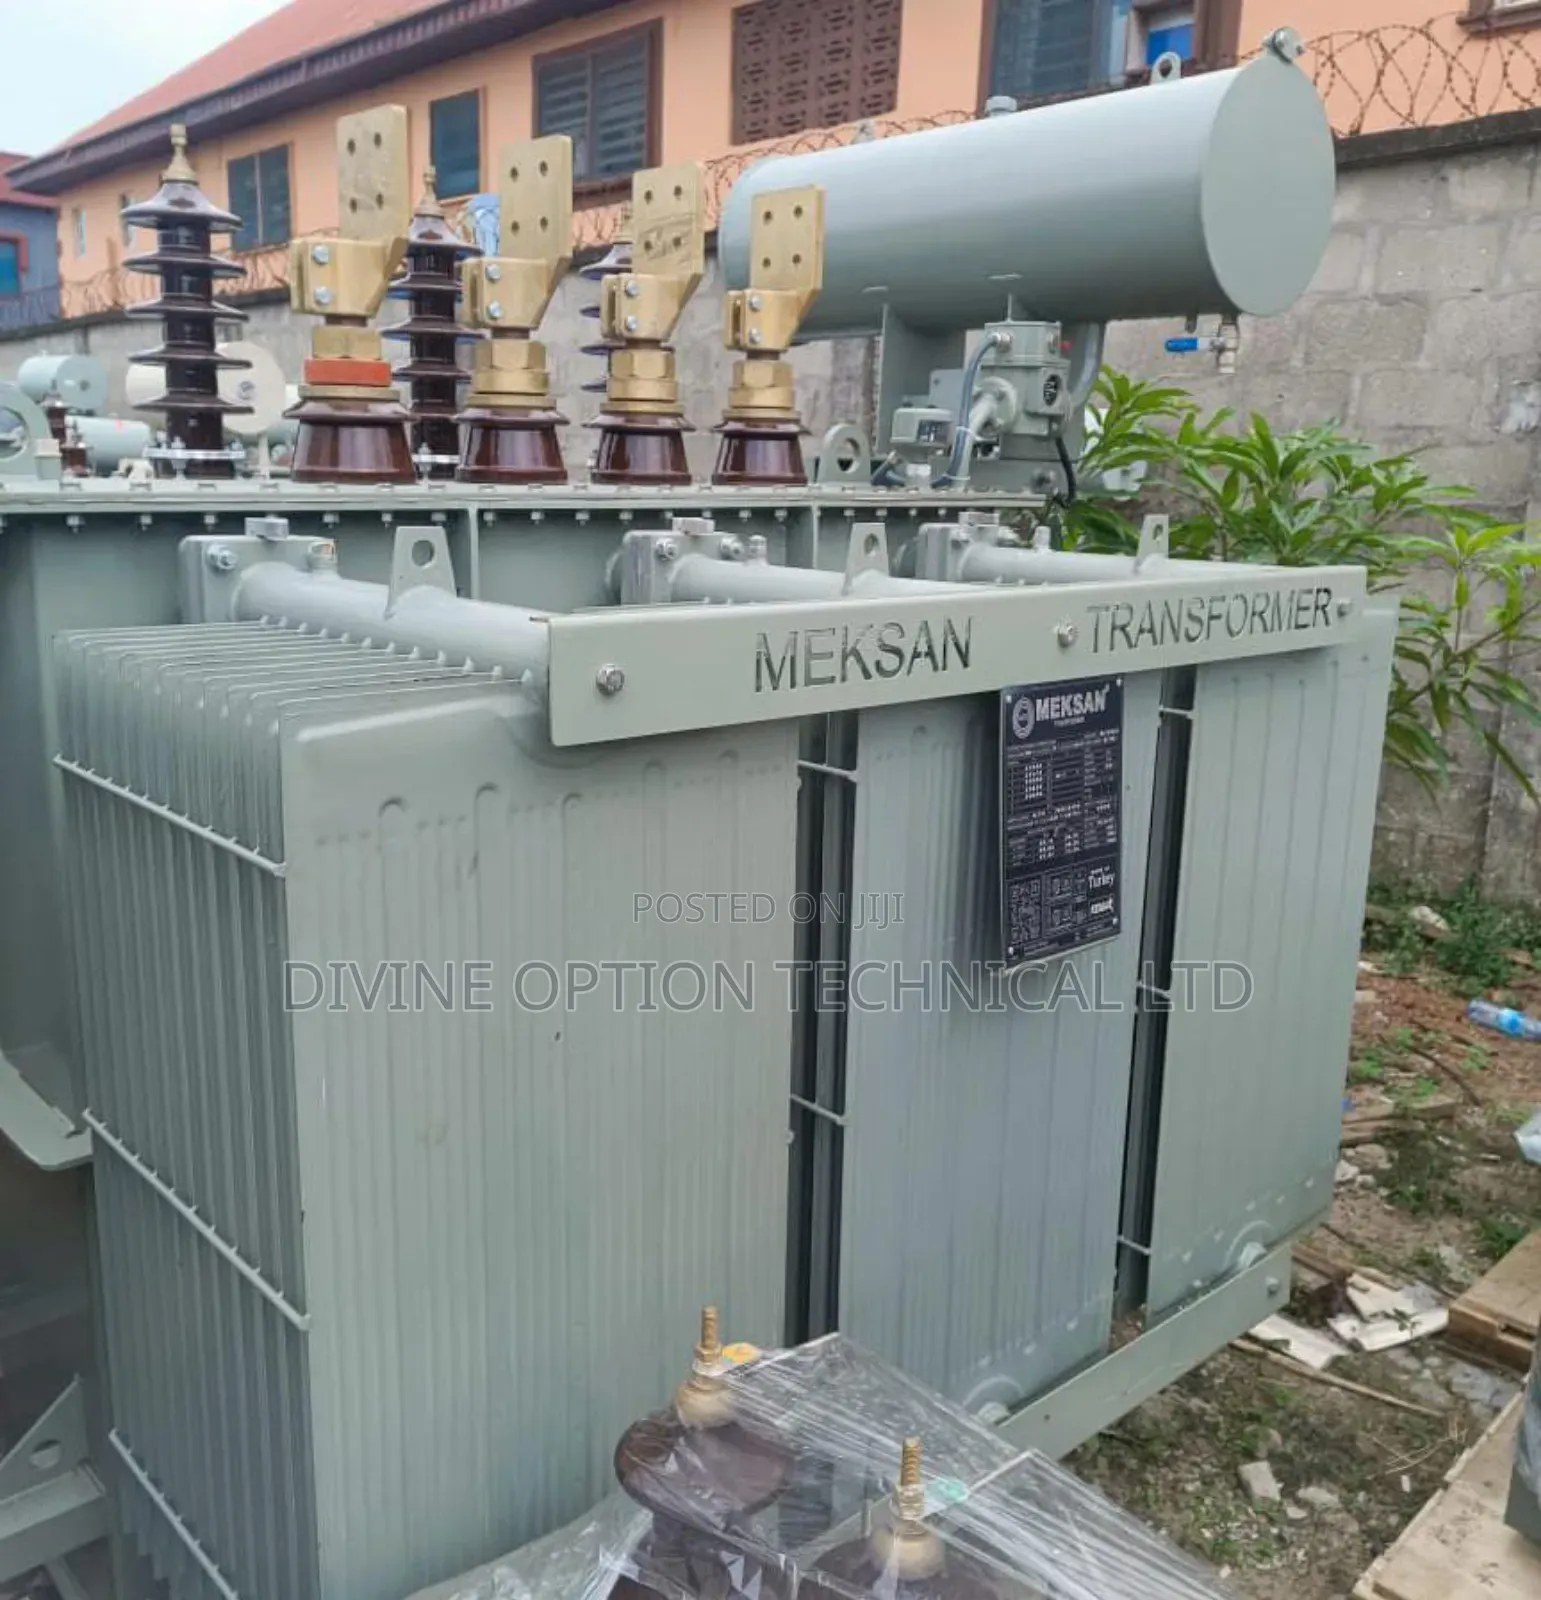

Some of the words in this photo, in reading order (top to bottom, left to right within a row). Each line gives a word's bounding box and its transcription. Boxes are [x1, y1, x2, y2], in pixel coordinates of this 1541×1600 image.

[755, 616, 973, 692] MEKSAN
[1086, 586, 1333, 654] TRANSFORMER
[1036, 690, 1106, 721] MEKSAN
[1088, 873, 1115, 889] Turkey
